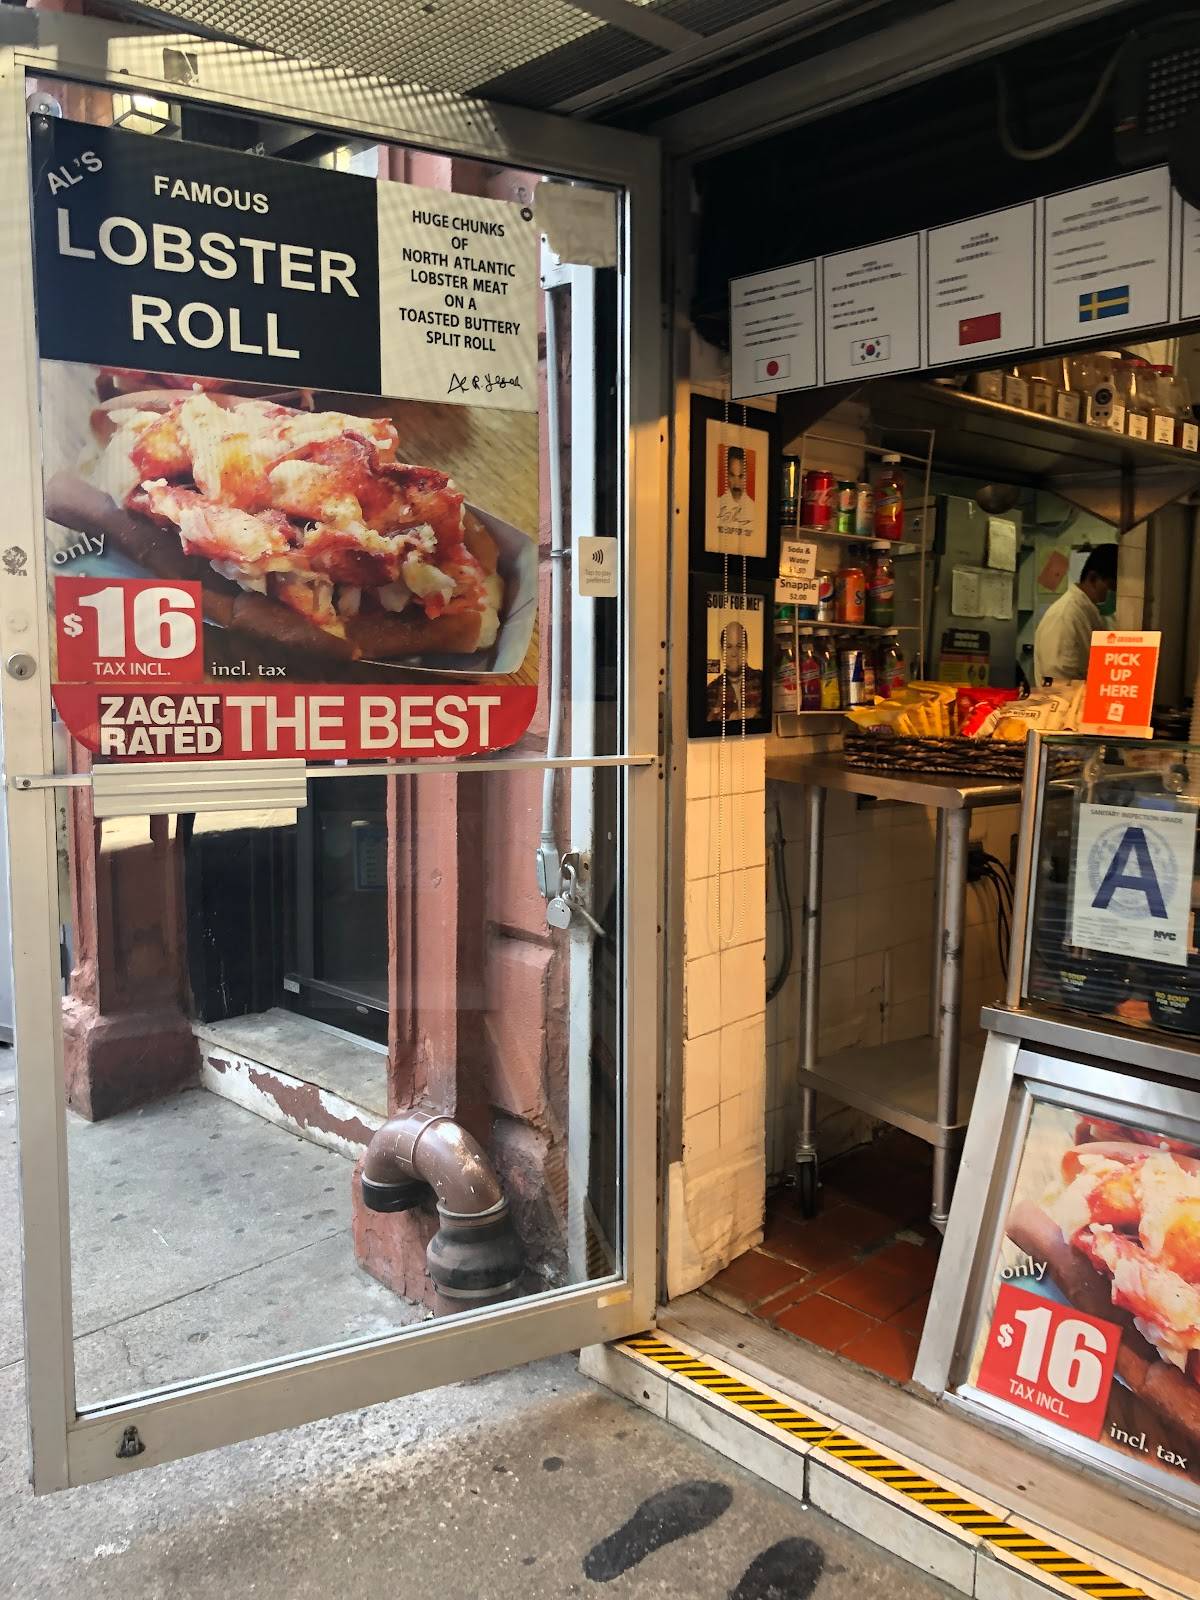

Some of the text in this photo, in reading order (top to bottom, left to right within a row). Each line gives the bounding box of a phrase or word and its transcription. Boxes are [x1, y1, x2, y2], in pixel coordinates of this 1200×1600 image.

[47, 151, 102, 195] AL'S
[154, 175, 269, 214] FAMOUS
[413, 210, 505, 237] HUGE CHUNKS
[58, 208, 359, 297] LOBSTER
[451, 236, 468, 251] OF
[402, 248, 516, 277] NORTH ATLANTIC
[411, 269, 508, 295] LOBSTER MEAT
[444, 294, 478, 310] ON A
[132, 294, 300, 359] ROLL
[399, 307, 520, 336] TOASTED BUTTERY
[426, 331, 496, 351] SPLIT ROLL
[53, 531, 105, 564] only
[780, 579, 817, 591] Snapple
[93, 662, 171, 676] TAX INCL.
[211, 661, 286, 677] incl. tax
[1104, 653, 1140, 666] PICK
[1110, 669, 1132, 681] UP
[1099, 684, 1138, 698] HERE
[101, 696, 220, 725] ZAGAT
[226, 695, 500, 751] THE BEST
[101, 726, 222, 755] RATED
[1091, 827, 1168, 920] A
[1154, 930, 1176, 941] NYC
[1001, 1255, 1048, 1281] only
[1009, 1378, 1070, 1419] TAX INCL.
[1110, 1422, 1188, 1470] incl. tax
